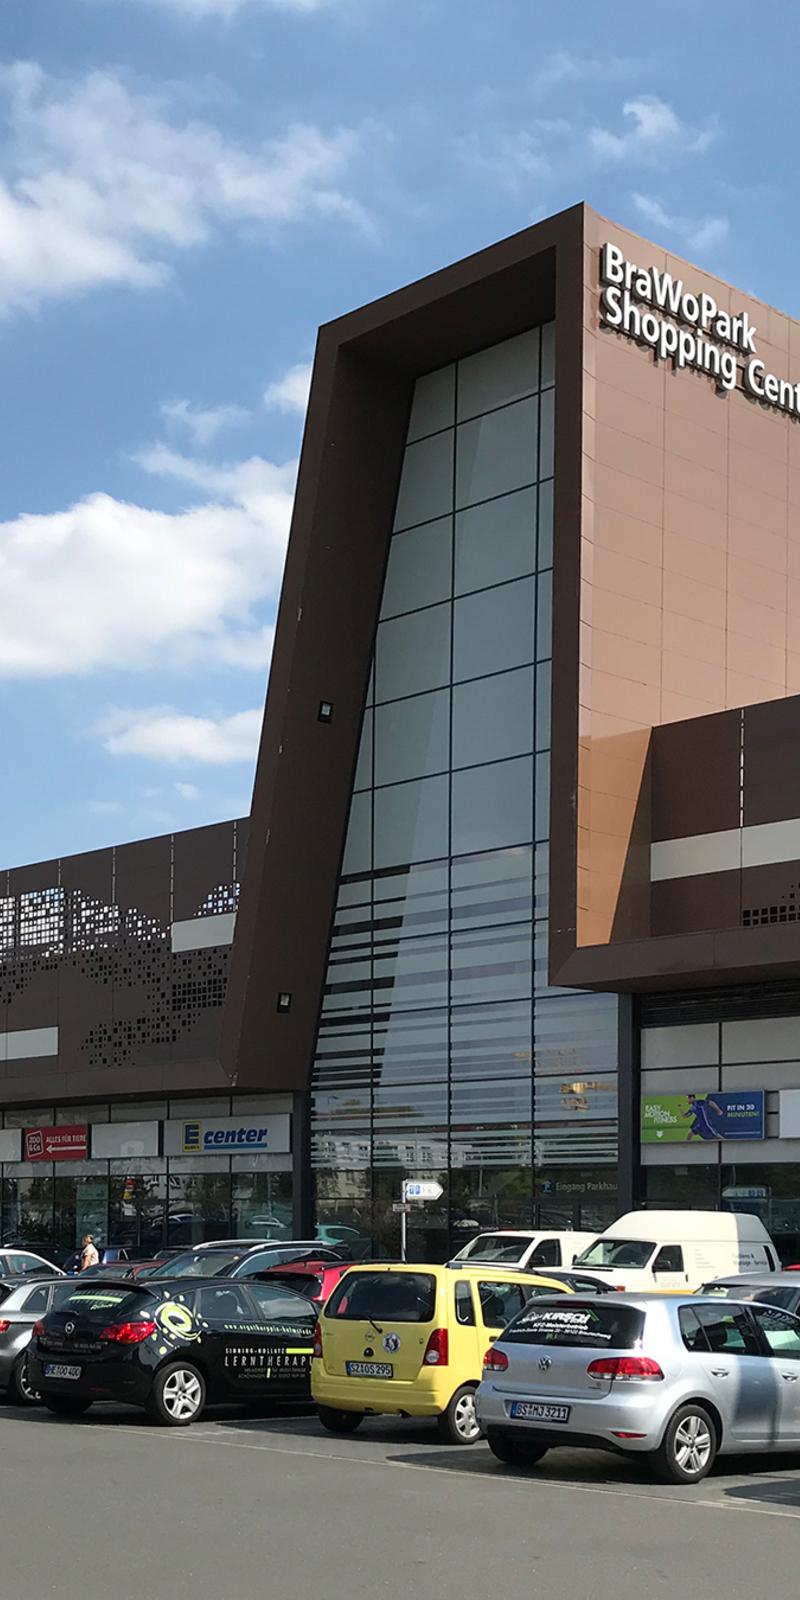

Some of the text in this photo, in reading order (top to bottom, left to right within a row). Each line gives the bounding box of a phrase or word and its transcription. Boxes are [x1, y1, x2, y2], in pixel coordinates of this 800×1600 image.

[601, 242, 756, 353] BraWoPark
[602, 286, 737, 390] Shopping
[45, 1135, 61, 1143] ALLES
[185, 1124, 268, 1144] E center
[555, 1182, 585, 1193] Eingang
[375, 1365, 391, 1375] 295
[545, 1406, 567, 1419] 3211
